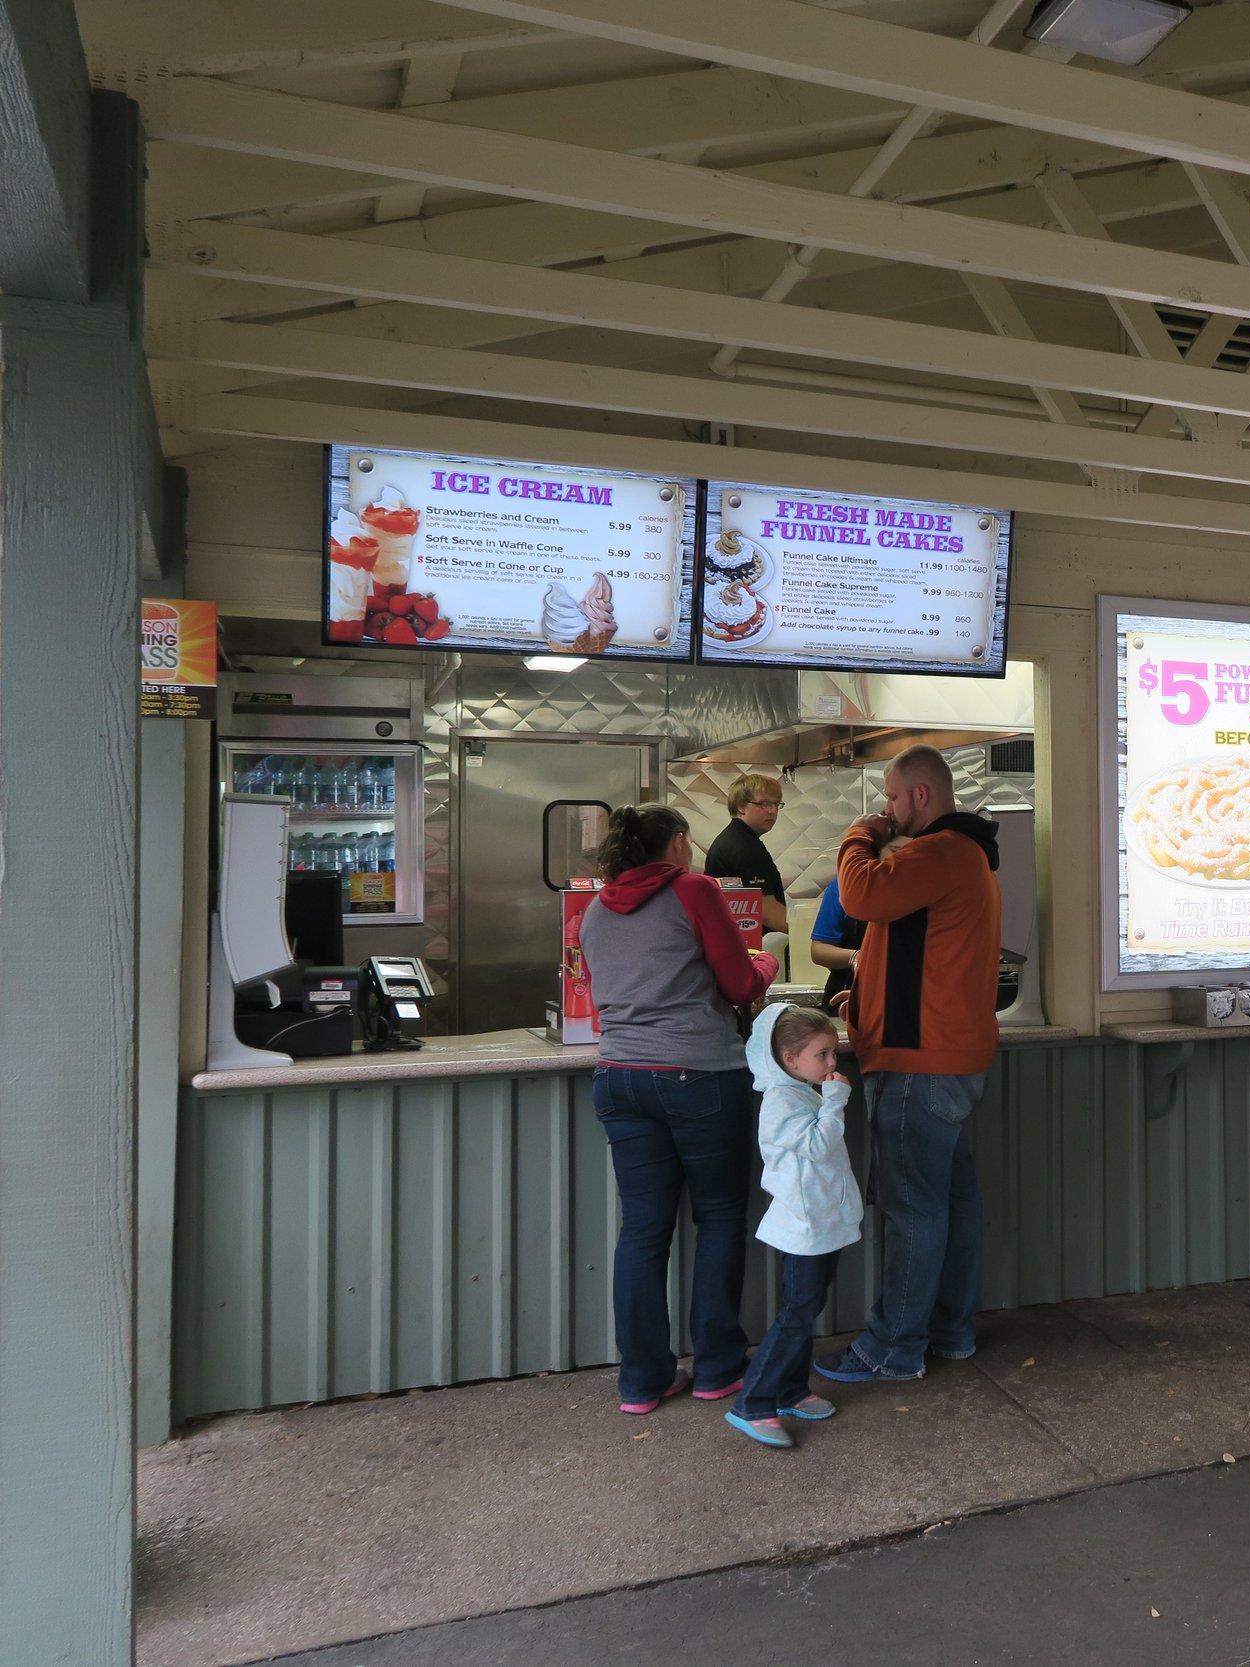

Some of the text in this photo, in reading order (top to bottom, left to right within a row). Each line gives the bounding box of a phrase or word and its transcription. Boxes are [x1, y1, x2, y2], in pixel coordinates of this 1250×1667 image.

[432, 472, 613, 506] ICE CREAM
[426, 506, 559, 525] Strawberries and Cream
[639, 515, 668, 523] calories
[776, 501, 952, 532] FRESH MADE
[426, 515, 456, 523] Delicious
[480, 520, 523, 528] strawberries
[525, 523, 550, 531] layered
[559, 526, 588, 534] between
[609, 522, 662, 533] 5.99 380
[426, 535, 449, 543] Soft
[452, 537, 482, 546] Serve
[499, 540, 533, 550] Waffle
[537, 544, 563, 553] Cone
[761, 520, 963, 553] FUNNEL CAKES
[608, 549, 661, 560] 5.99 300
[783, 552, 877, 565] Funnel Cake Ultimate
[425, 556, 448, 565] Soft
[452, 558, 482, 568] Serve
[498, 562, 525, 571] Cone
[543, 565, 563, 575] Cup
[920, 562, 987, 573] 11.99 1100-1480
[607, 570, 670, 581] 4.99 160-230
[782, 579, 878, 592] Funnel Cake Supreme
[945, 590, 983, 598] 960-1200
[782, 606, 811, 614] Funnel
[955, 616, 971, 624] 860
[798, 622, 834, 630] chocolate
[883, 626, 905, 634] funnel
[955, 630, 970, 639] 140
[140, 634, 177, 646] ING
[1139, 658, 1211, 726] $5
[1175, 899, 1208, 919] Try
[1211, 898, 1226, 916] It
[1161, 921, 1208, 938] Time
